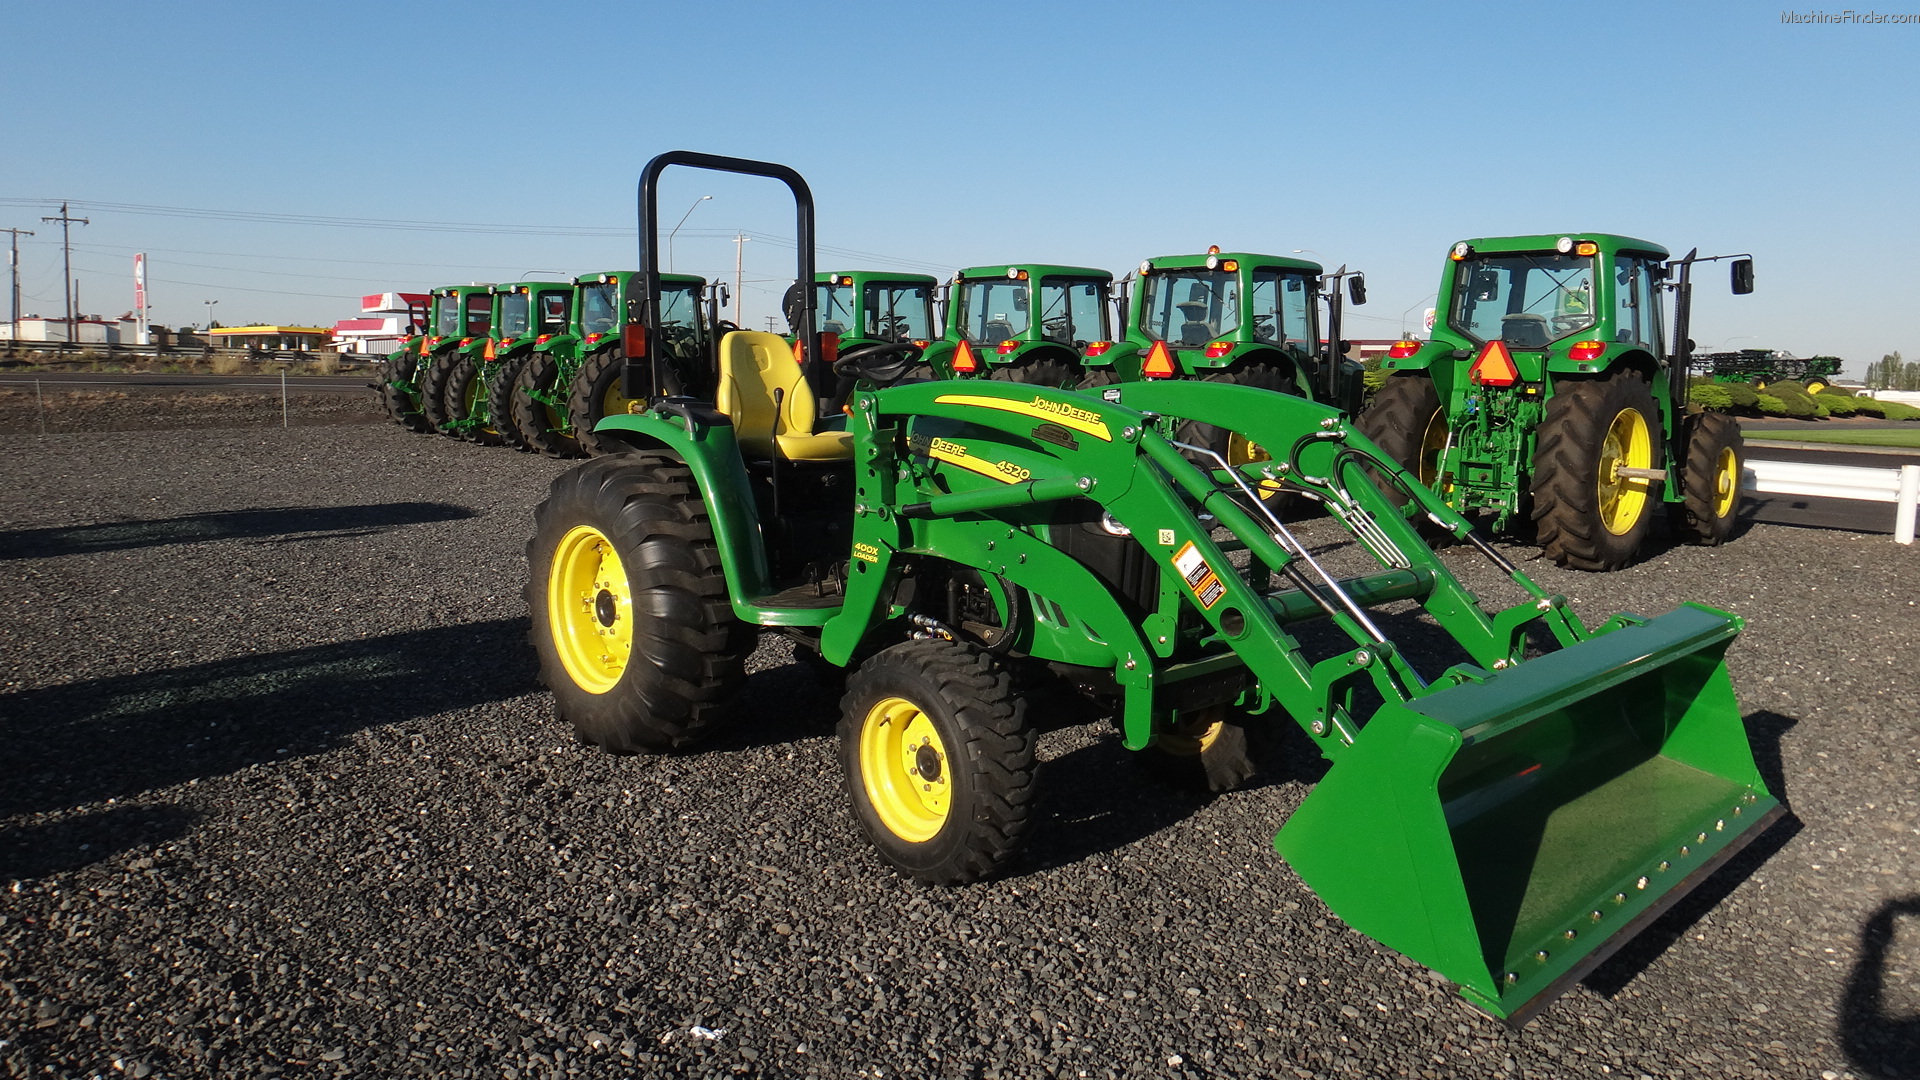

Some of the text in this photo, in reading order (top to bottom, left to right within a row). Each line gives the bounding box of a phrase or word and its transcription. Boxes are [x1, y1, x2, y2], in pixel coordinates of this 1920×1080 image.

[1030, 395, 1102, 424] JOHN DEERE
[930, 437, 967, 457] DEERE
[996, 460, 1031, 480] 4520
[853, 550, 878, 563] LOADER
[855, 542, 879, 556] 400X
